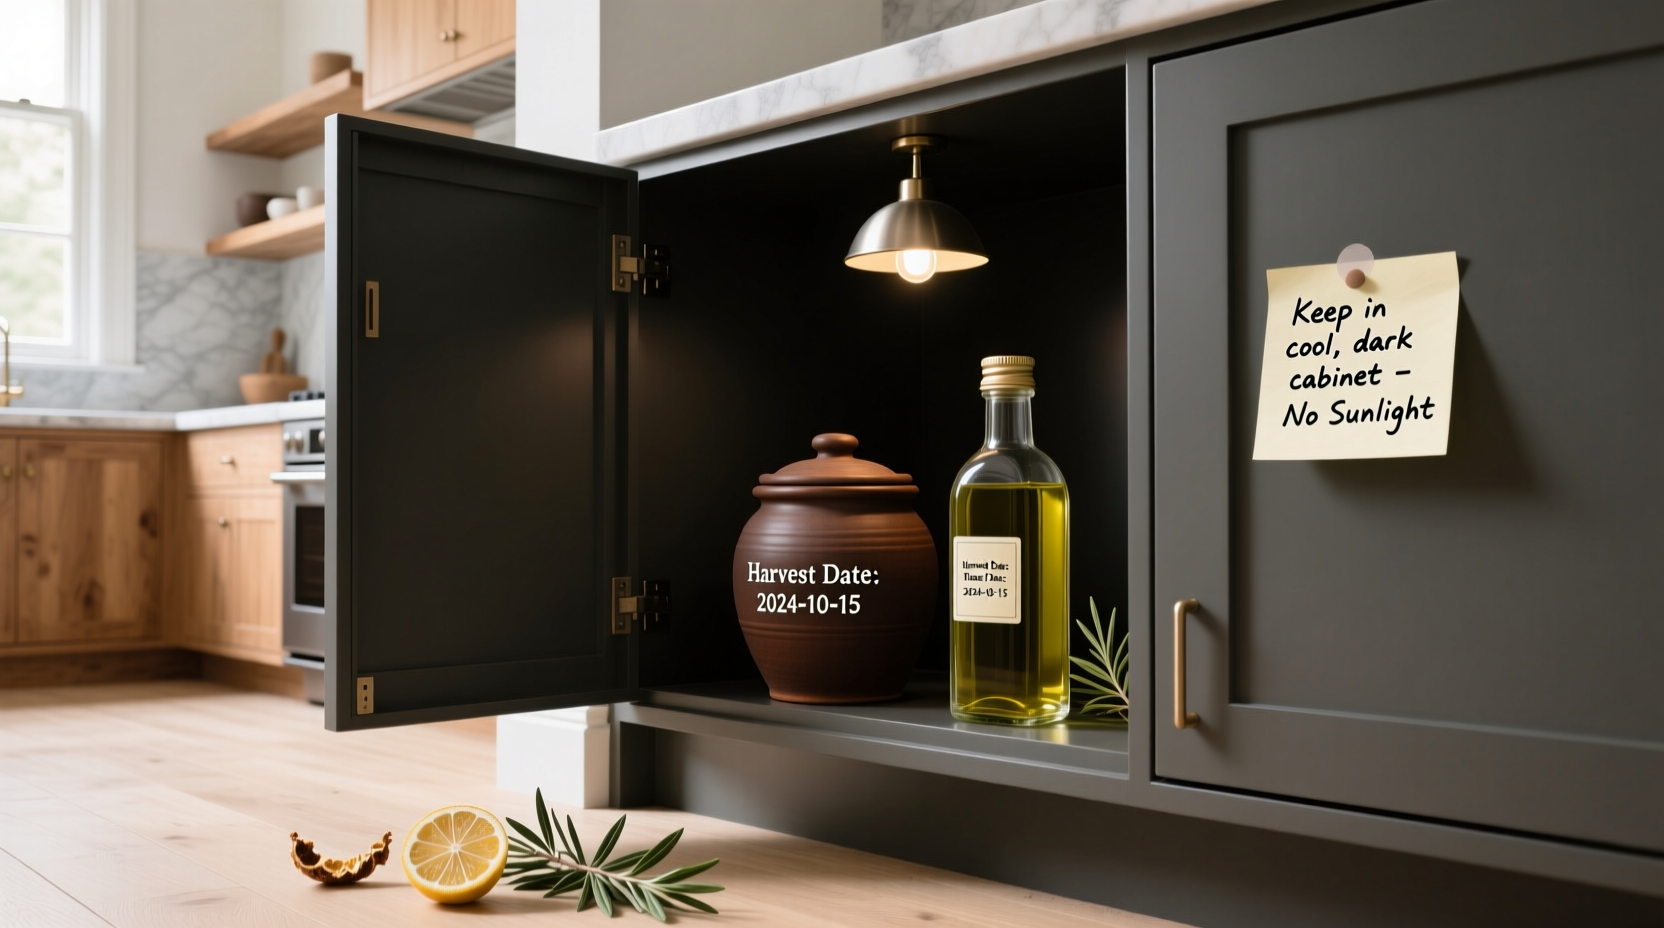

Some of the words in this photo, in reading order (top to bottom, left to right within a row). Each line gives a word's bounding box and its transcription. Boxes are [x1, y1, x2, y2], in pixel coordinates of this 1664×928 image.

[1292, 297, 1353, 333] Keep
[1364, 297, 1386, 319] in
[1285, 332, 1340, 360] cool,
[1353, 325, 1413, 353] dark
[1289, 363, 1383, 390] cabinet
[1282, 401, 1319, 427] No
[1328, 394, 1436, 436] Sunlight
[747, 561, 816, 585] Harvest
[822, 563, 879, 585] Date:
[756, 592, 861, 615] 2024-10-15
